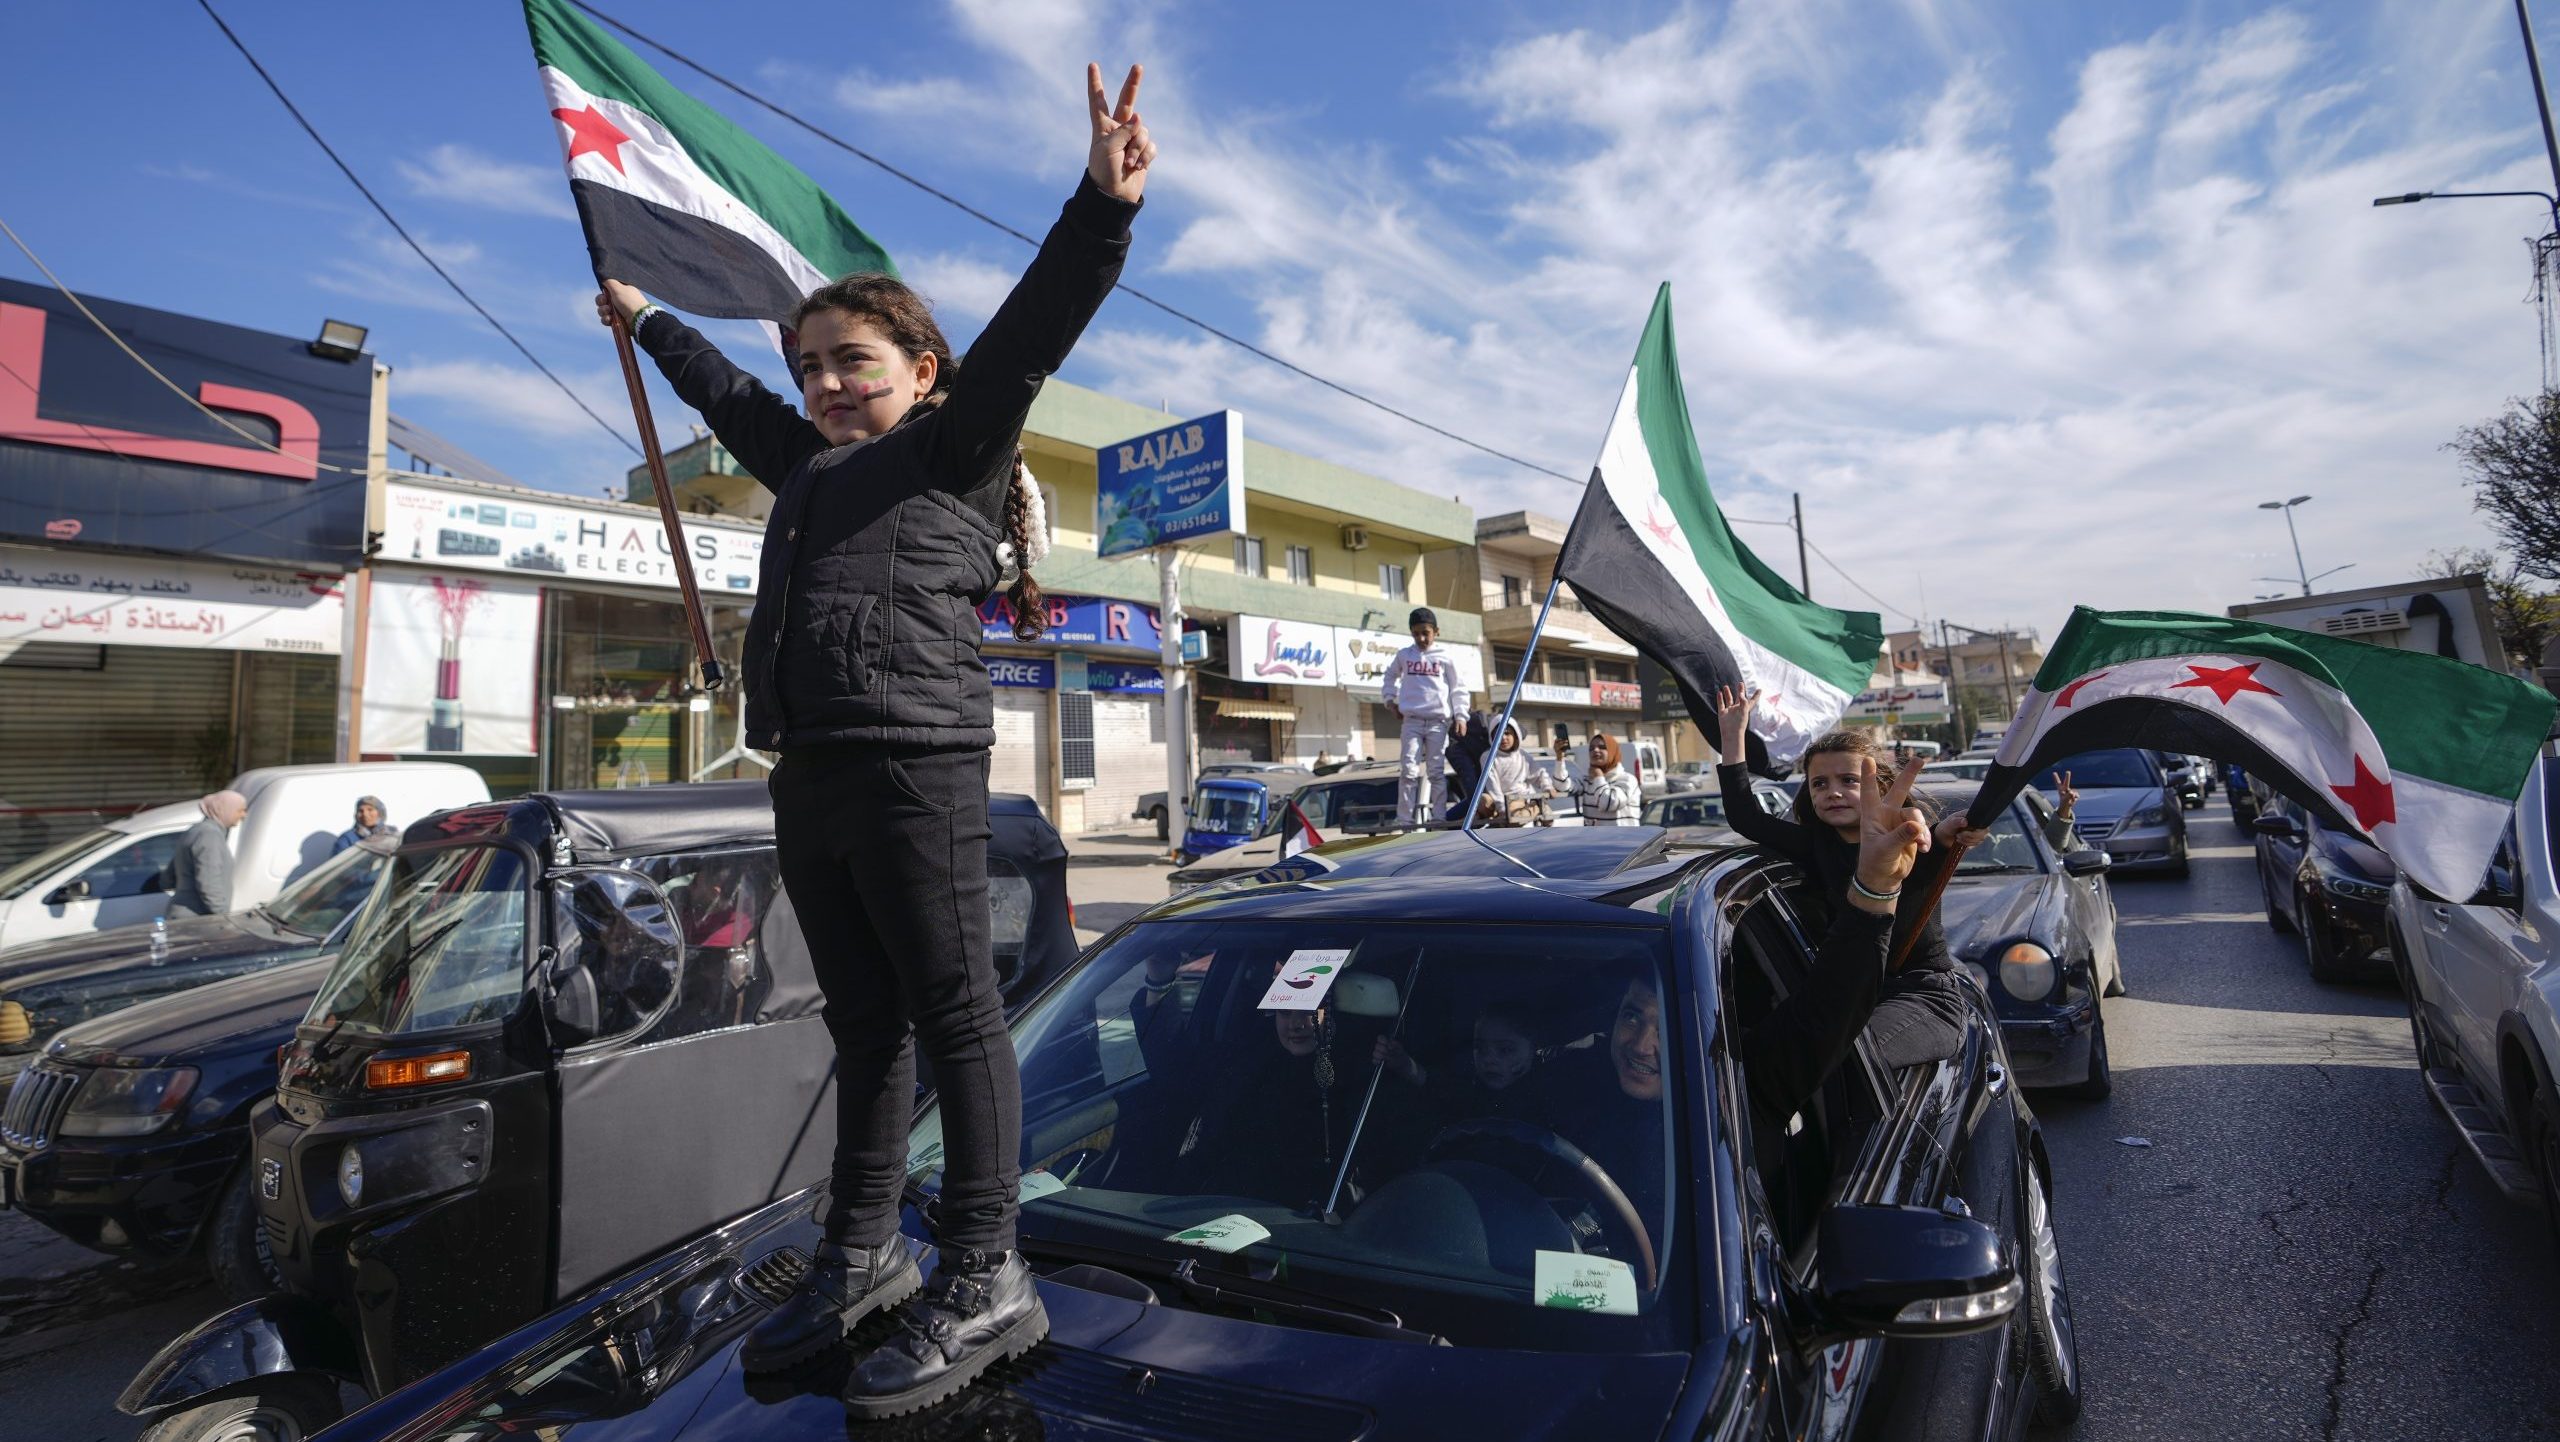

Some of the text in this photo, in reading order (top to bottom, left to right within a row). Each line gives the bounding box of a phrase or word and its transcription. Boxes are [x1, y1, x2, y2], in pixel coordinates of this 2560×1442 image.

[1118, 425, 1205, 474] RAJAB
[1165, 511, 1219, 533] 03/651843
[41, 605, 112, 634] إيمان
[126, 606, 225, 634] الأستاذة
[987, 663, 1041, 684] GREE
[1407, 661, 1441, 673] POLO
